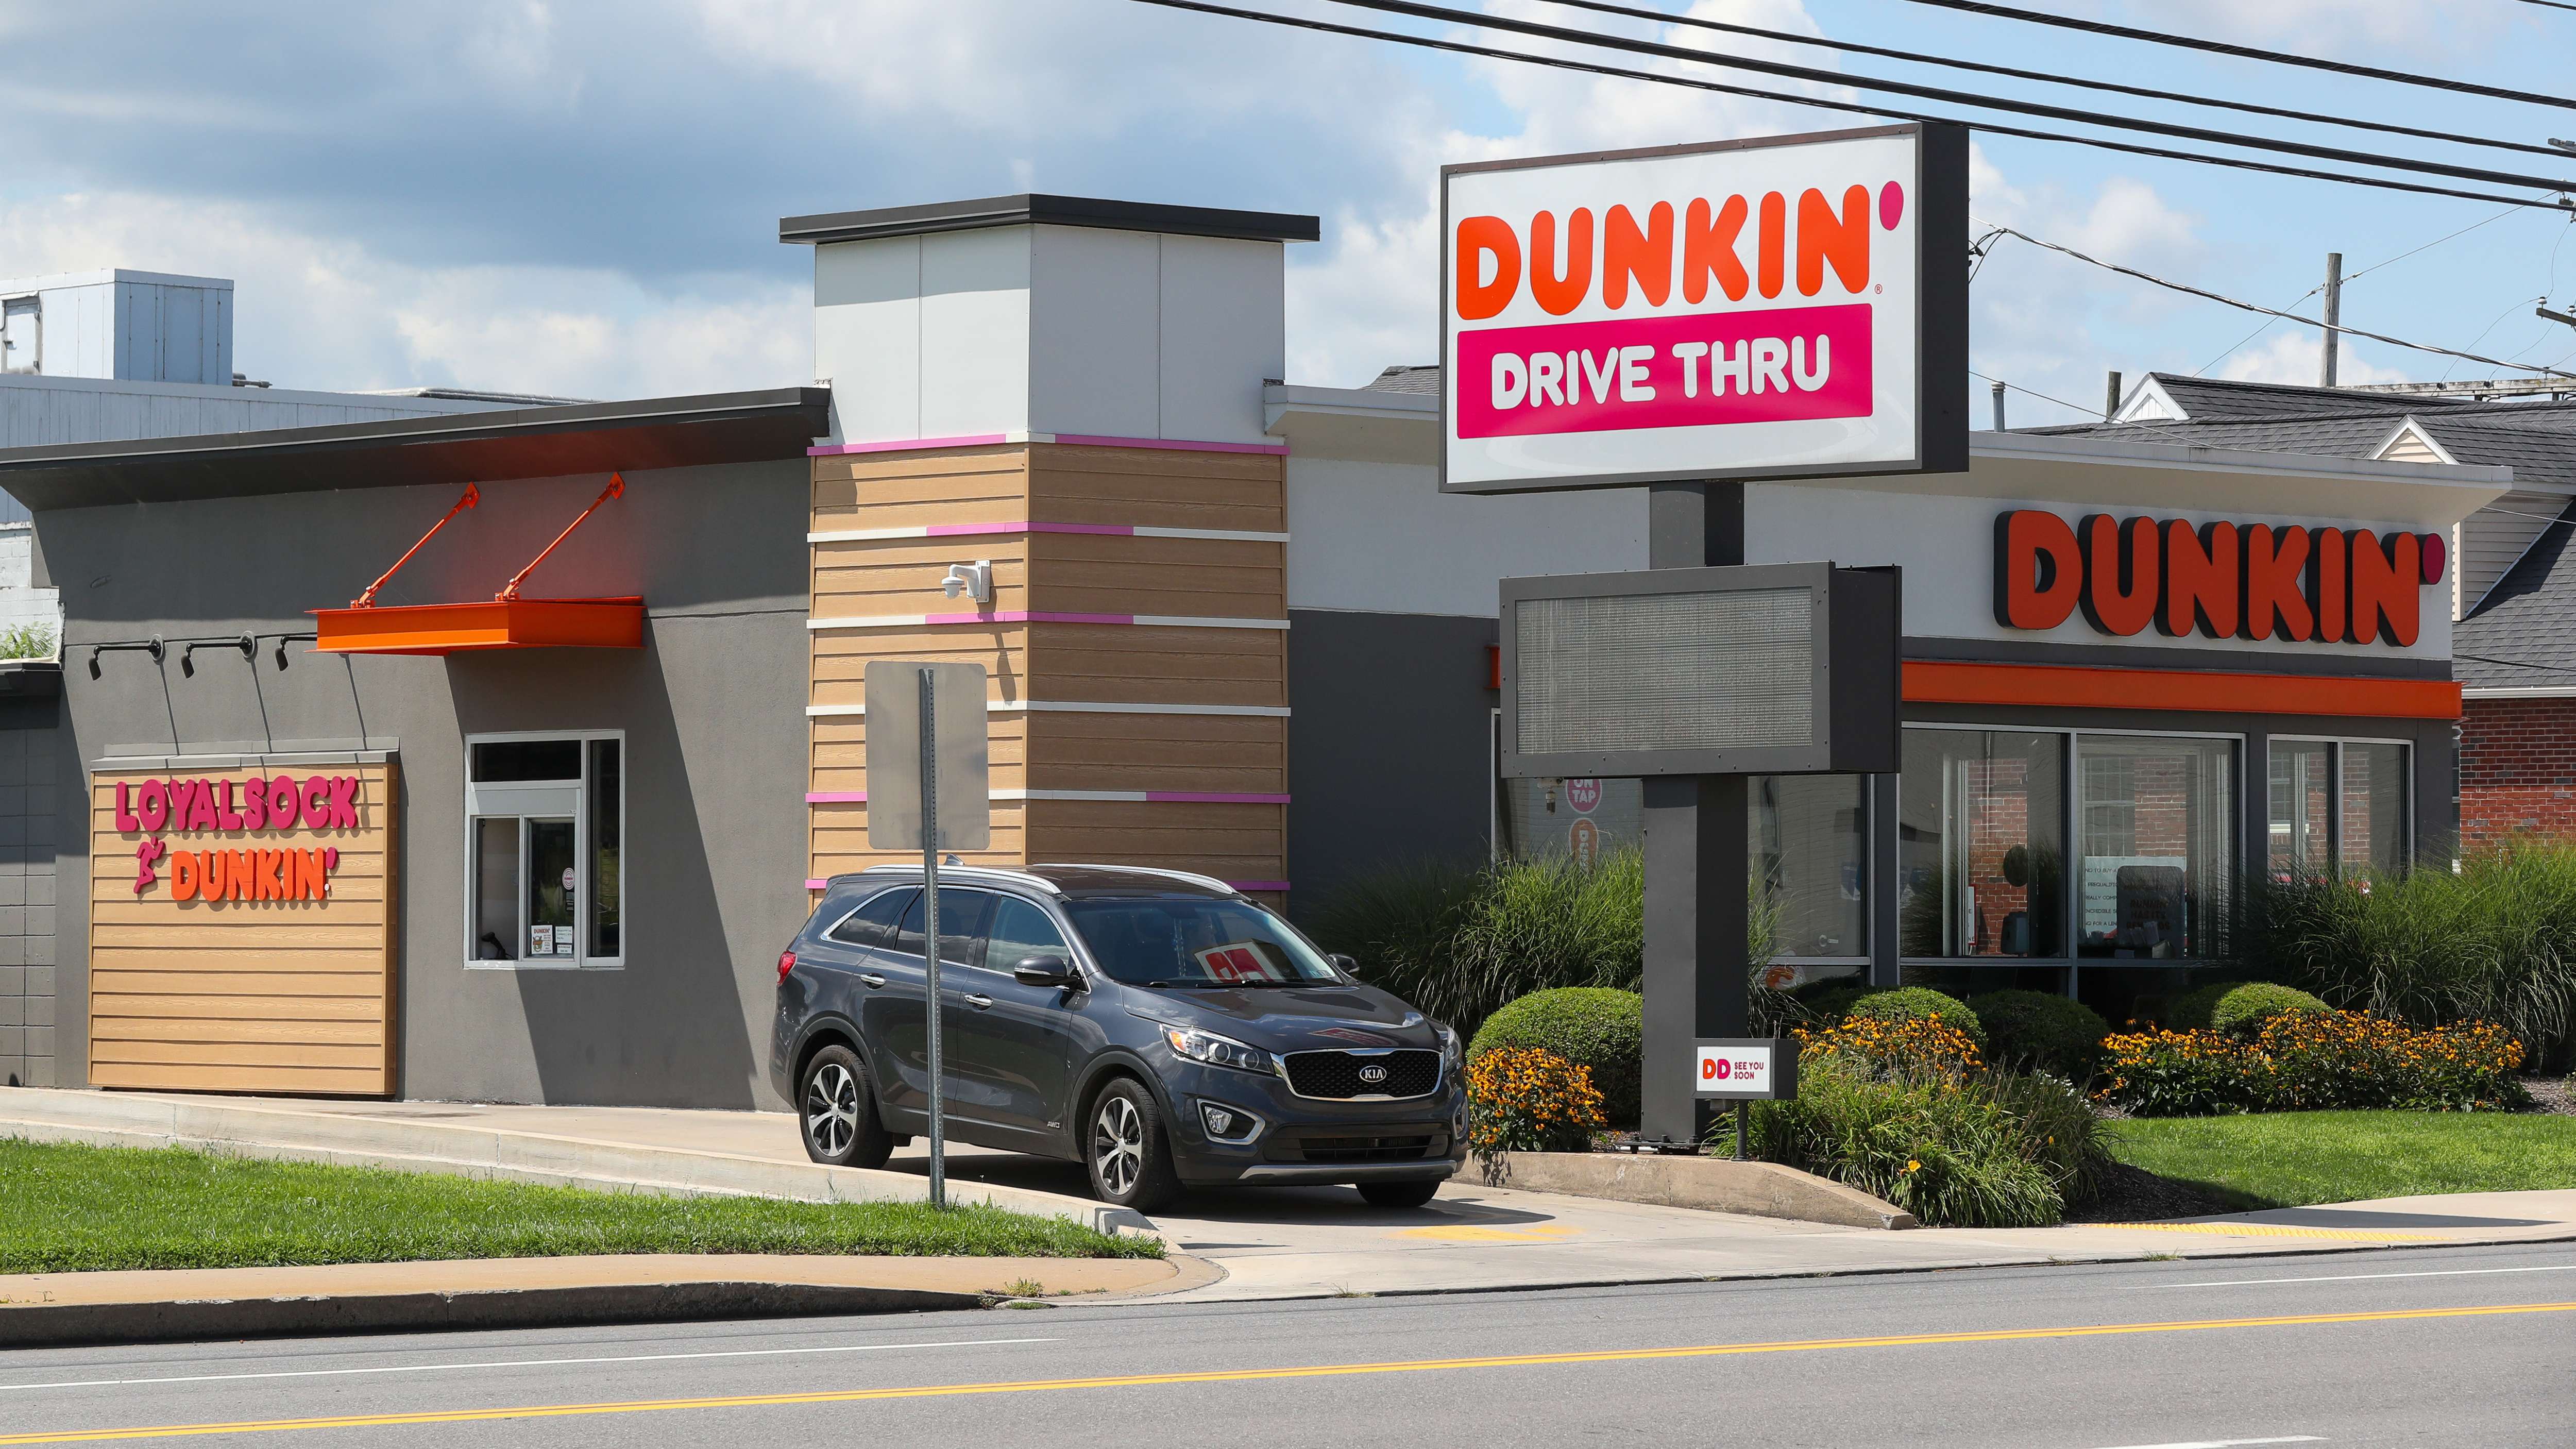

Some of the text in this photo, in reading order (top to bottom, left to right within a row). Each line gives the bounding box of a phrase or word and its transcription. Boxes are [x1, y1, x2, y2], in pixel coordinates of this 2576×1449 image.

[1456, 181, 1904, 320] DUNKIN'
[1491, 334, 1830, 410] DRIVE THRU
[1994, 509, 2446, 648] DUNKIN'
[115, 775, 358, 832] LOYALSOCK
[1572, 790, 1596, 803] TAP
[171, 847, 340, 902] DUNKIN'
[1365, 1069, 1383, 1079] KIA
[1703, 1058, 1731, 1080] DD
[1734, 1062, 1764, 1070] SEE YOU
[1734, 1071, 1755, 1080] SOON
